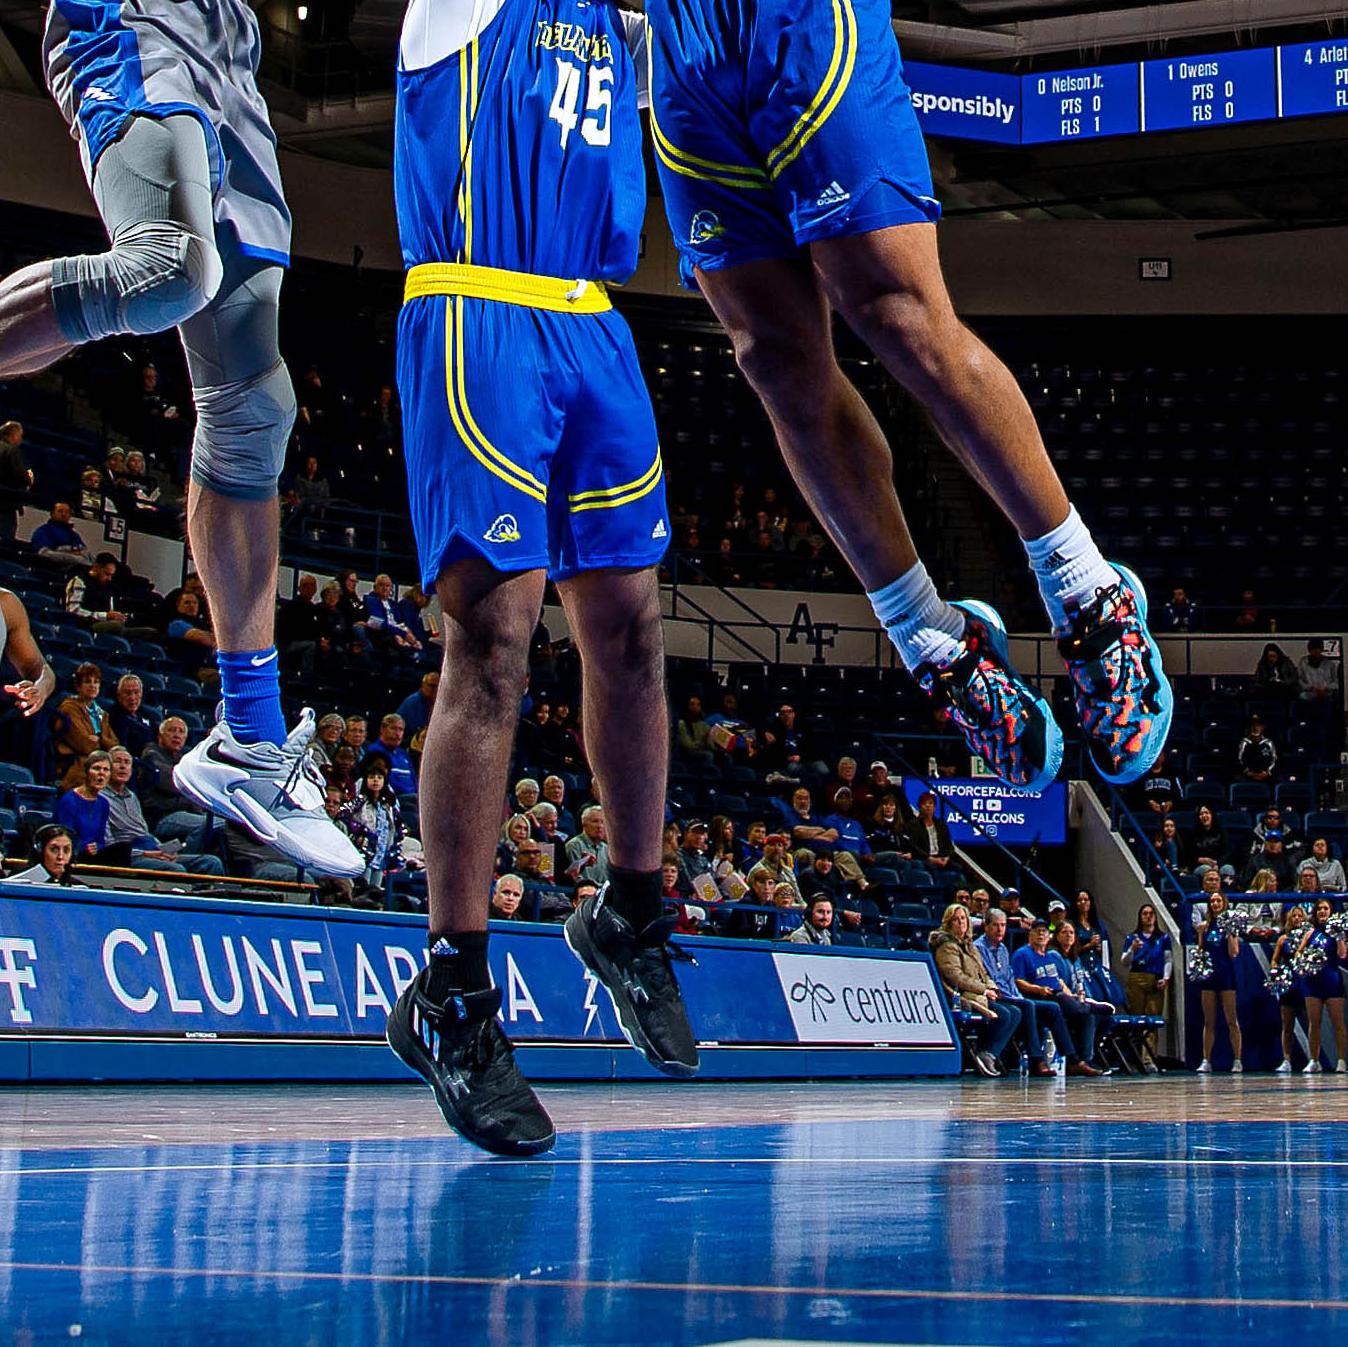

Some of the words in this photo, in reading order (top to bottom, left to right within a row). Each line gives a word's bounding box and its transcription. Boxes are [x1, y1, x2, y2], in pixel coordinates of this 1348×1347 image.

[1304, 50, 1312, 64] 4
[1180, 61, 1218, 77] Owens
[1038, 78, 1045, 95] 0
[1052, 76, 1089, 93] Nelson
[1192, 83, 1213, 101] PTS
[1225, 80, 1233, 97] 0
[549, 57, 614, 150] 45
[907, 91, 1014, 123] sponsibly
[1061, 96, 1081, 115] PTS
[1093, 95, 1101, 112] 0
[1193, 104, 1212, 121] FLS
[1225, 101, 1233, 119] 0
[1061, 117, 1079, 136] FLS
[1094, 117, 1100, 132] 1
[786, 603, 838, 664] AF
[102, 928, 339, 1017] CLUNE
[356, 941, 543, 1022] ARA
[843, 974, 940, 1025] centura
